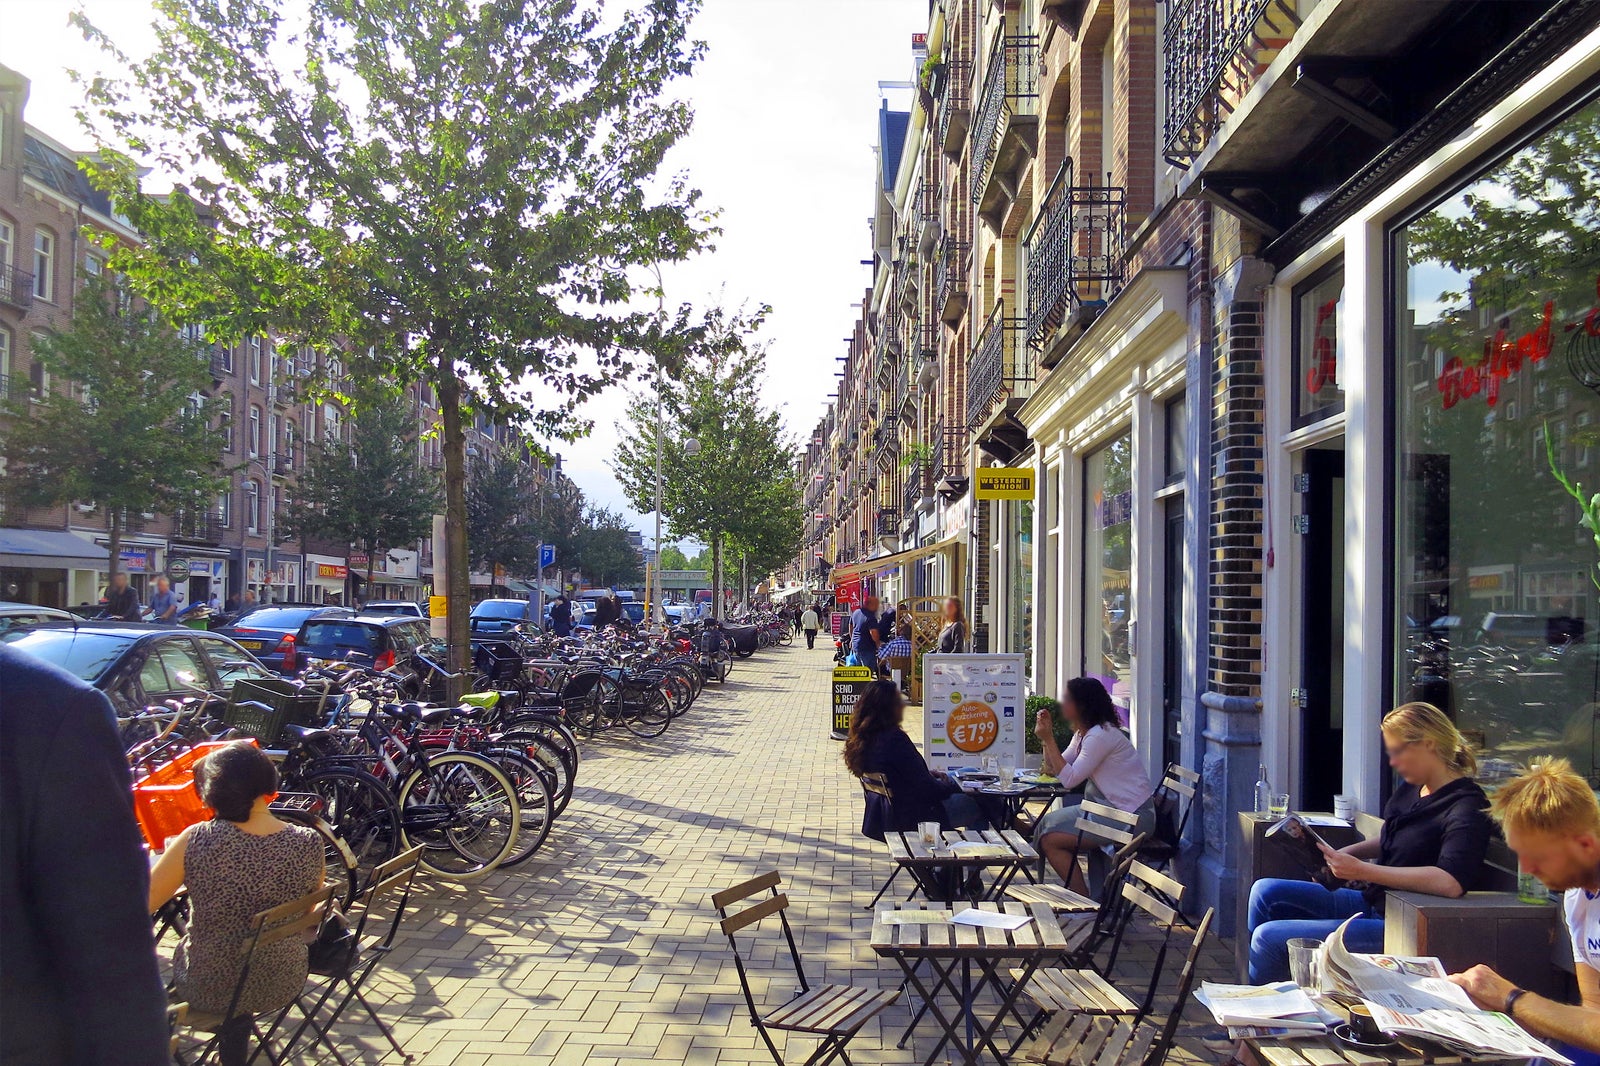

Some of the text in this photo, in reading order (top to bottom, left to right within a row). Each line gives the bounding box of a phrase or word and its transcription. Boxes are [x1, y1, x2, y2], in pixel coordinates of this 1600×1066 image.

[544, 550, 550, 561] P
[835, 684, 853, 694] SEND
[835, 695, 841, 704] &
[835, 714, 849, 729] HE
